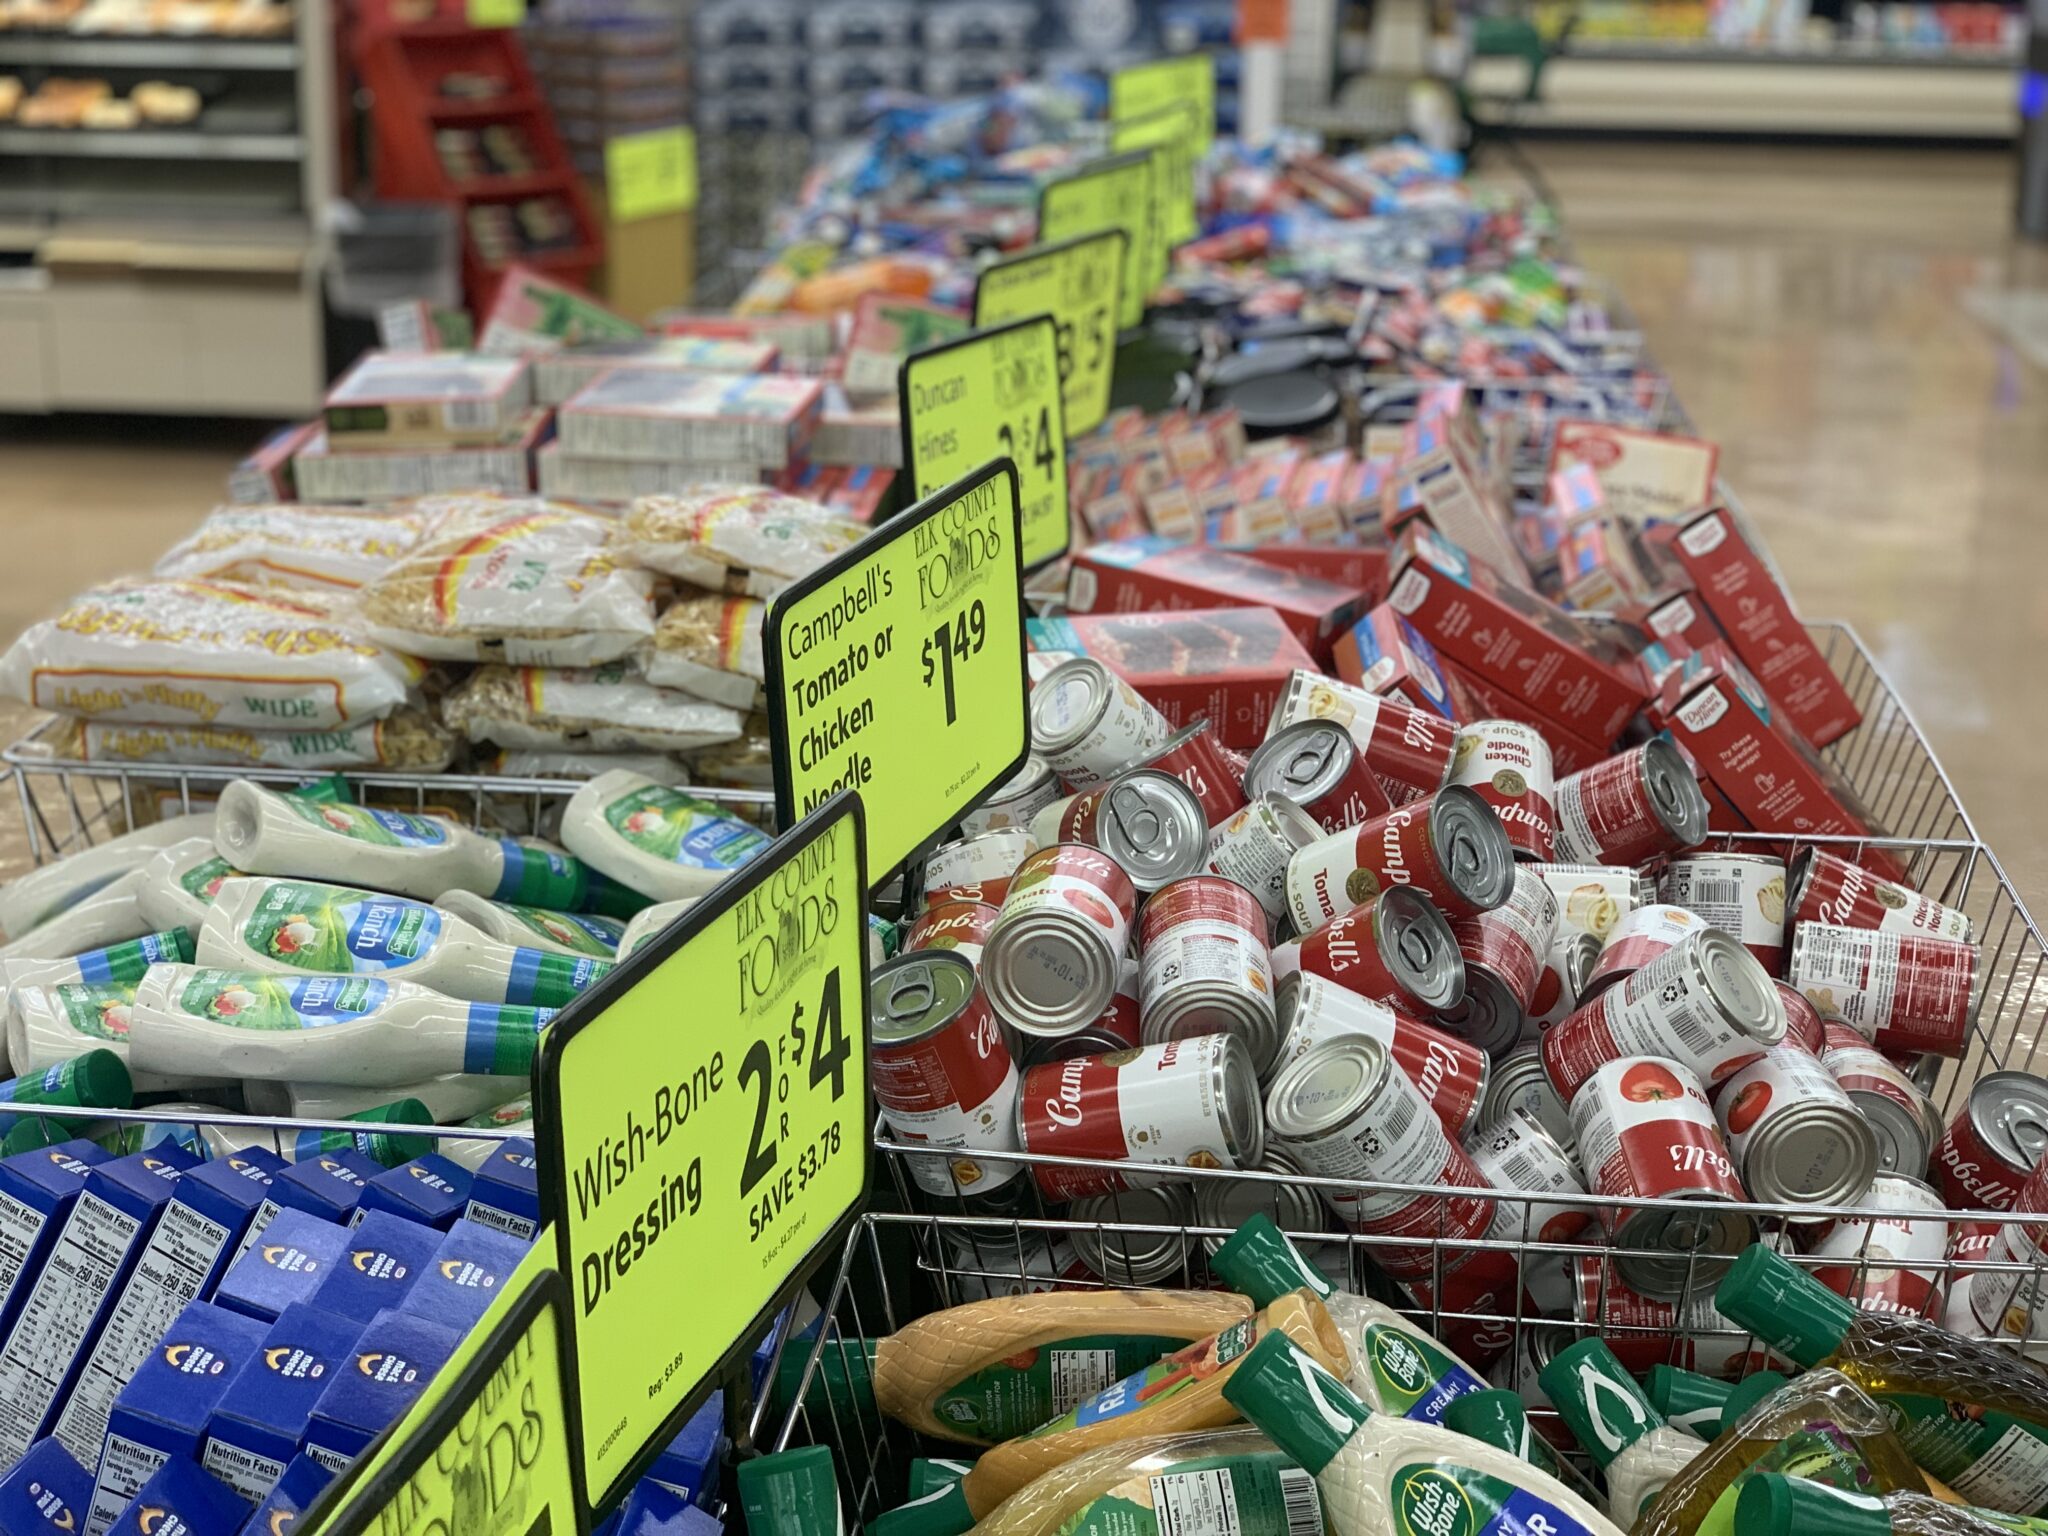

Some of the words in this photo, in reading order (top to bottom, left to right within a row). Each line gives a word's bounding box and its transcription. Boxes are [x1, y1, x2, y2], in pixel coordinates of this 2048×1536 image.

[914, 374, 967, 415] Duncan
[918, 427, 959, 466] Hines
[913, 518, 939, 560] ELK
[942, 478, 997, 537] COUNTY
[787, 563, 894, 661] Campbell's
[792, 643, 869, 717] Tomato
[873, 624, 894, 660] or
[243, 696, 319, 719] WIDE
[287, 731, 358, 756] WIDE
[799, 697, 875, 773] Chicken
[1487, 741, 1530, 756] Noodle
[1491, 725, 1527, 737] SOUP
[1718, 747, 1732, 763] Try
[1730, 733, 1754, 754] these
[1484, 752, 1533, 769] Chicken
[1723, 738, 1761, 771] ingredient
[1735, 751, 1763, 773] swaps!
[802, 751, 873, 816] Noodle
[735, 886, 766, 946] ELK
[770, 823, 839, 911] COUNTY
[1312, 867, 1336, 921] Toma
[1291, 892, 1313, 929] SOUP
[572, 1050, 725, 1222] Wish-Bone
[737, 1038, 778, 1200] 2
[749, 1167, 794, 1243] SAVE
[797, 1120, 841, 1192] $3.78
[1941, 1128, 2018, 1210] mpbell's
[19, 1208, 42, 1228] Facts
[82, 1196, 115, 1222] Nutrition
[113, 1214, 136, 1234] Facts
[170, 1204, 203, 1230] Nutrition
[202, 1222, 224, 1242] Facts
[471, 1207, 508, 1226] Nutrition
[507, 1218, 532, 1235] Facts
[581, 1156, 703, 1318] Dressing
[53, 1254, 76, 1275] Calories
[75, 1265, 93, 1283] 250
[91, 1274, 109, 1293] 350
[140, 1262, 163, 1284] Calories
[162, 1272, 181, 1292] 250
[179, 1281, 197, 1301] 350
[664, 1351, 684, 1383] $3.89
[1397, 1350, 1420, 1389] Bone
[1425, 1380, 1462, 1418] CREAMY
[106, 1460, 124, 1475] Serving
[110, 1438, 152, 1464] Nutrition
[210, 1443, 252, 1467] Nutrition
[252, 1459, 280, 1478] Facts
[310, 1448, 346, 1471] Nutritio
